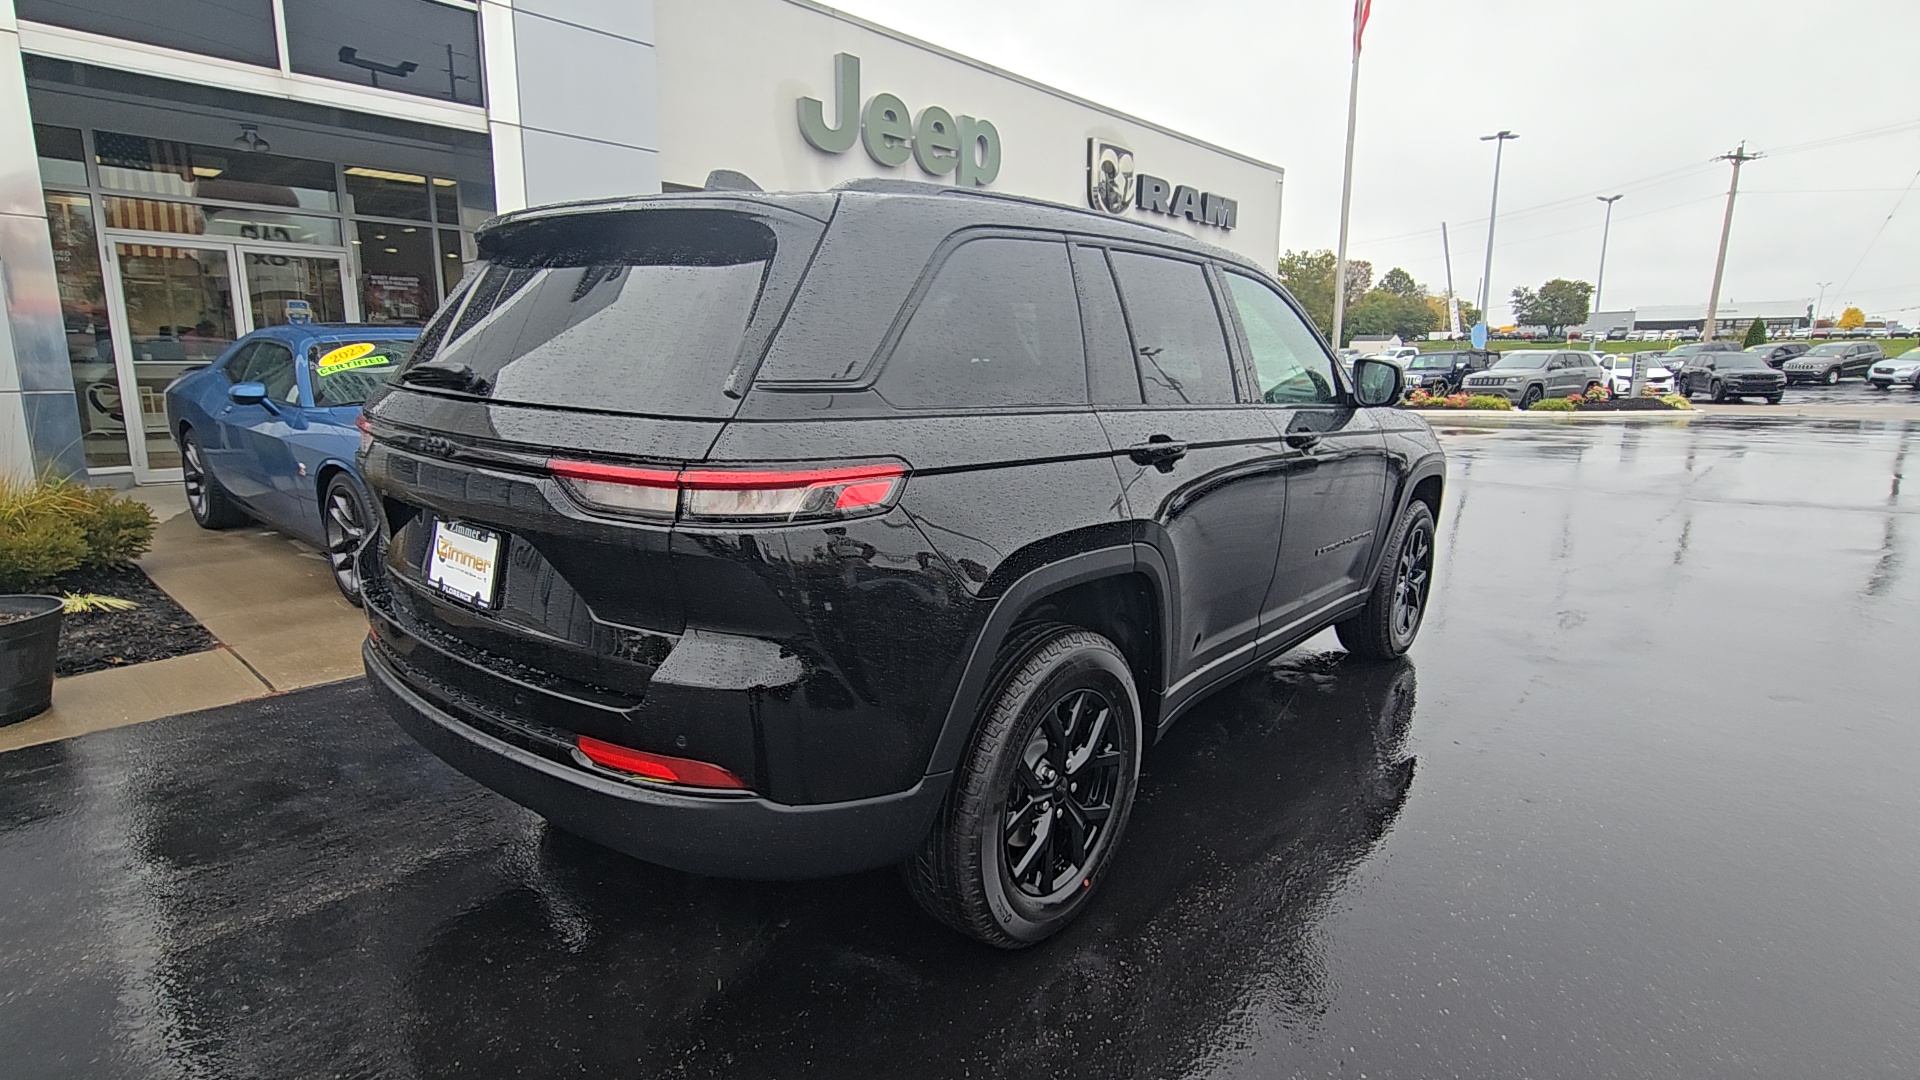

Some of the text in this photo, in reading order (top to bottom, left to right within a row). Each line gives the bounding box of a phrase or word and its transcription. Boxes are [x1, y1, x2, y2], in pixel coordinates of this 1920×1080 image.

[798, 52, 1001, 186] Jeep
[1136, 174, 1238, 230] RAM
[330, 345, 366, 363] 2023
[319, 357, 385, 375] CERTIFIED
[448, 522, 481, 540] Zimmer
[438, 538, 492, 573] Zimmer
[442, 586, 472, 603] FLORENCE
